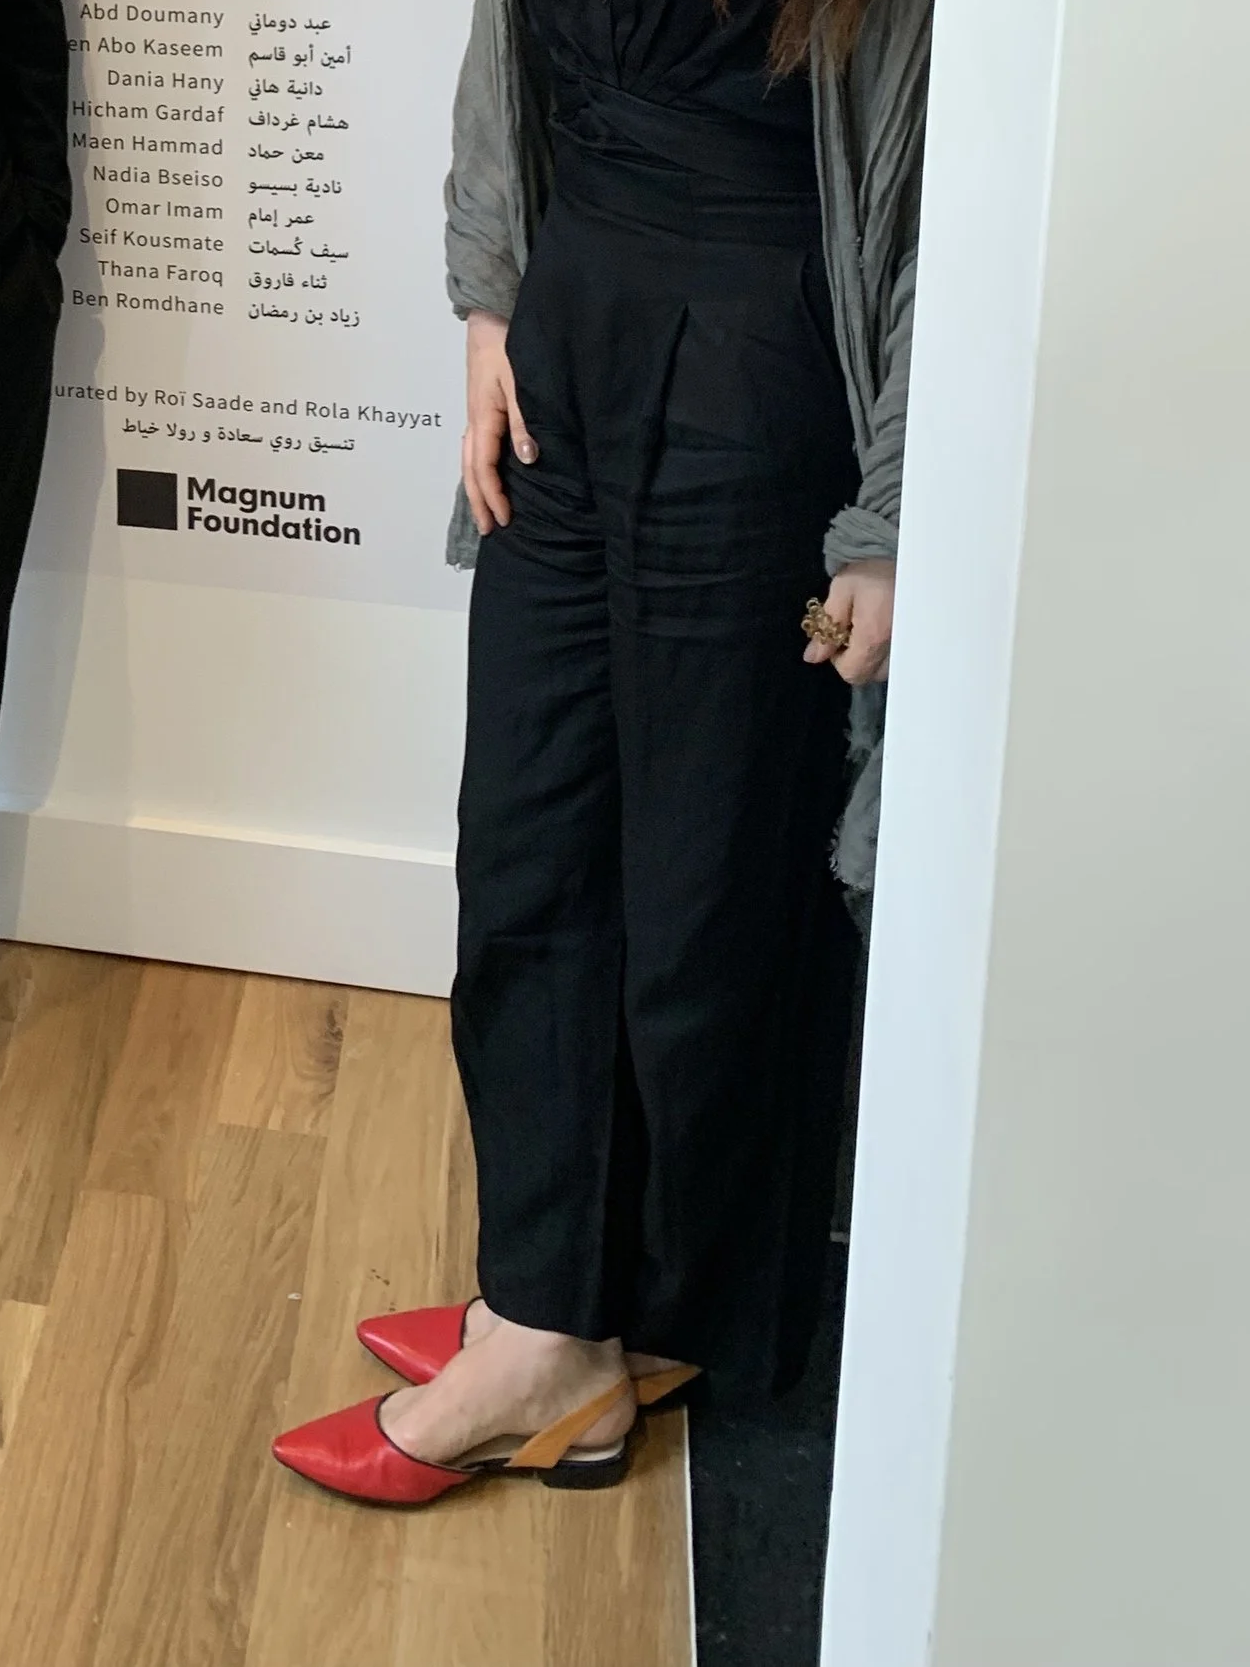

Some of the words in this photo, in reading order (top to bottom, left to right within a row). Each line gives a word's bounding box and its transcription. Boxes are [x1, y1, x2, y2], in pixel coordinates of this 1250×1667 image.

[80, 3, 118, 20] Abd
[127, 5, 224, 28] Doumany
[249, 14, 297, 35] دوماني
[304, 19, 331, 30] عبد
[98, 37, 136, 54] Abo
[144, 39, 222, 57] Kaseem
[293, 44, 314, 67] أبو
[321, 45, 351, 69] أمين
[249, 47, 286, 68] قاسم
[108, 70, 164, 87] Dania
[172, 73, 223, 94] Hany
[249, 79, 279, 101] هاني
[287, 80, 322, 100] دانية
[73, 101, 148, 119] Hicham
[155, 104, 225, 122] Gardaf
[249, 111, 300, 131] غرداف
[307, 115, 349, 136] هشام
[73, 133, 124, 150] Maen
[133, 136, 222, 155] Hammad
[248, 144, 284, 159] حماد
[292, 149, 324, 164] معن
[94, 166, 150, 183] Nadia
[158, 169, 223, 187] Bseiso
[248, 182, 297, 196] بسيسو
[305, 178, 342, 197] نادية
[106, 198, 161, 215] Omar
[167, 201, 222, 219] Imam
[248, 208, 278, 229] إمام
[285, 215, 314, 228] عمر
[80, 228, 117, 245] Seif
[124, 231, 223, 251] Kousmate
[310, 244, 348, 263] سيف
[98, 260, 159, 278] Thana
[167, 265, 223, 287] Faroq
[249, 272, 294, 290] فاروق
[302, 275, 327, 289] ثناء
[73, 290, 108, 307] Ben
[117, 293, 224, 315] Romdhane
[249, 303, 298, 322] رمضان
[305, 309, 323, 326] بن
[330, 309, 359, 327] زياد
[55, 386, 117, 401] urated
[126, 386, 148, 407] by
[193, 393, 253, 412] Saade
[260, 399, 297, 415] and
[306, 401, 349, 419] Rola
[358, 406, 441, 429] Khayyat
[122, 418, 160, 438] خياط
[167, 423, 195, 441] رولا
[218, 427, 263, 443] سعادة
[270, 436, 301, 452] روي
[309, 437, 355, 453] تنسيق
[187, 476, 327, 512] Magnum
[187, 506, 362, 546] Foundation
